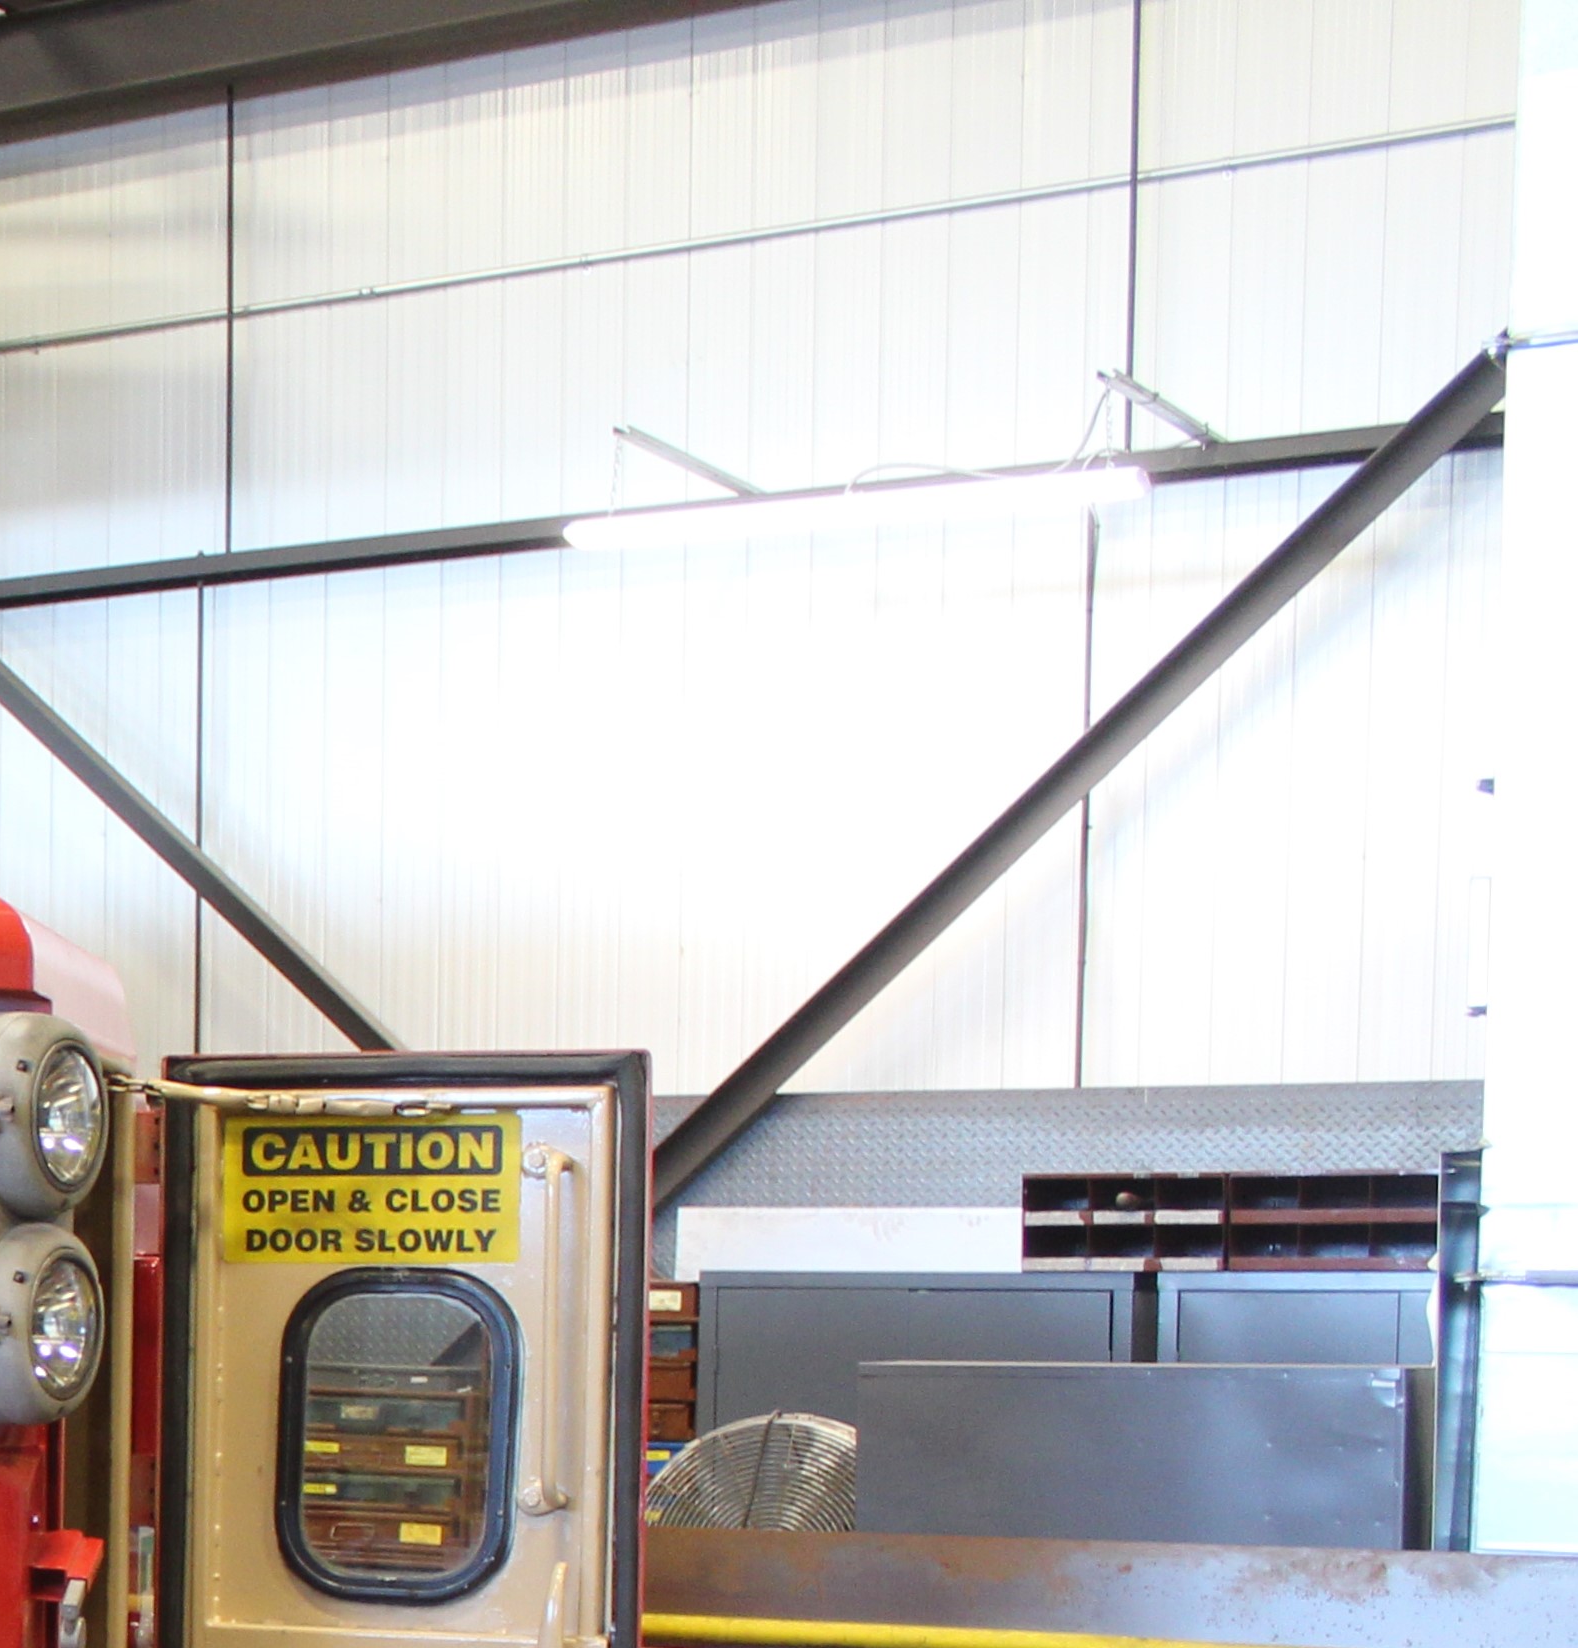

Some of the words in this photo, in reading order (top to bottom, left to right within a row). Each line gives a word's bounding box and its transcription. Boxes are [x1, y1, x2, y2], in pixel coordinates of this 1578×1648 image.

[250, 1131, 495, 1172] CAUTION
[242, 1188, 336, 1213] OPEN
[347, 1189, 372, 1213] &
[384, 1188, 502, 1213] CLOSE
[245, 1229, 343, 1253] DOOR
[354, 1228, 498, 1253] SLOWLY
